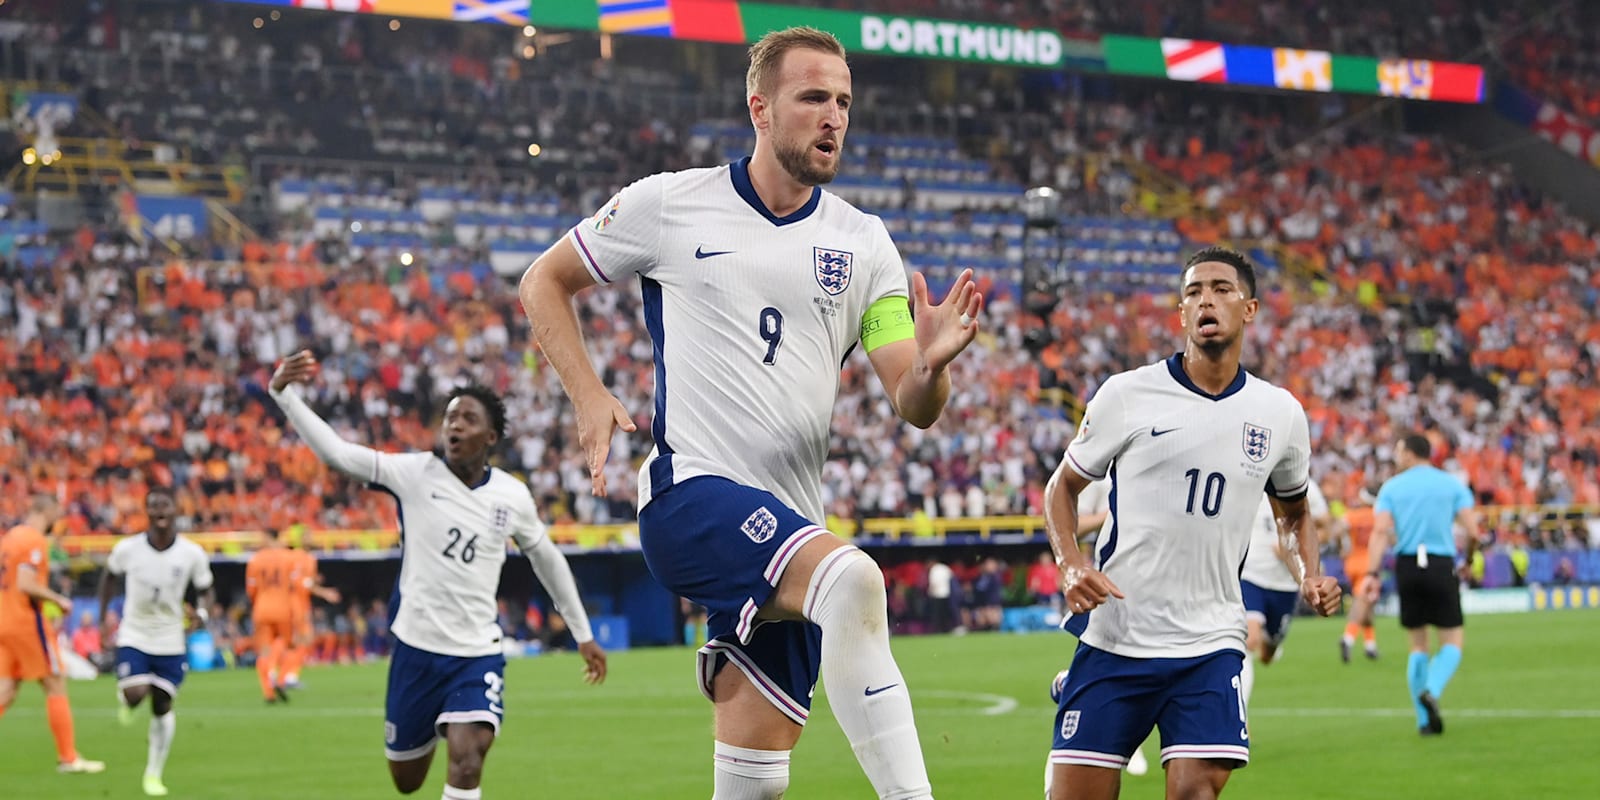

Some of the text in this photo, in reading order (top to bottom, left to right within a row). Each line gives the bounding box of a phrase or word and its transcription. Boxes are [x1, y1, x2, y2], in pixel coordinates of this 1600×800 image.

[860, 16, 1062, 65] DORTMUND
[759, 306, 784, 366] 9
[1184, 468, 1227, 518] 10
[443, 527, 478, 564] 26
[484, 671, 504, 705] 2
